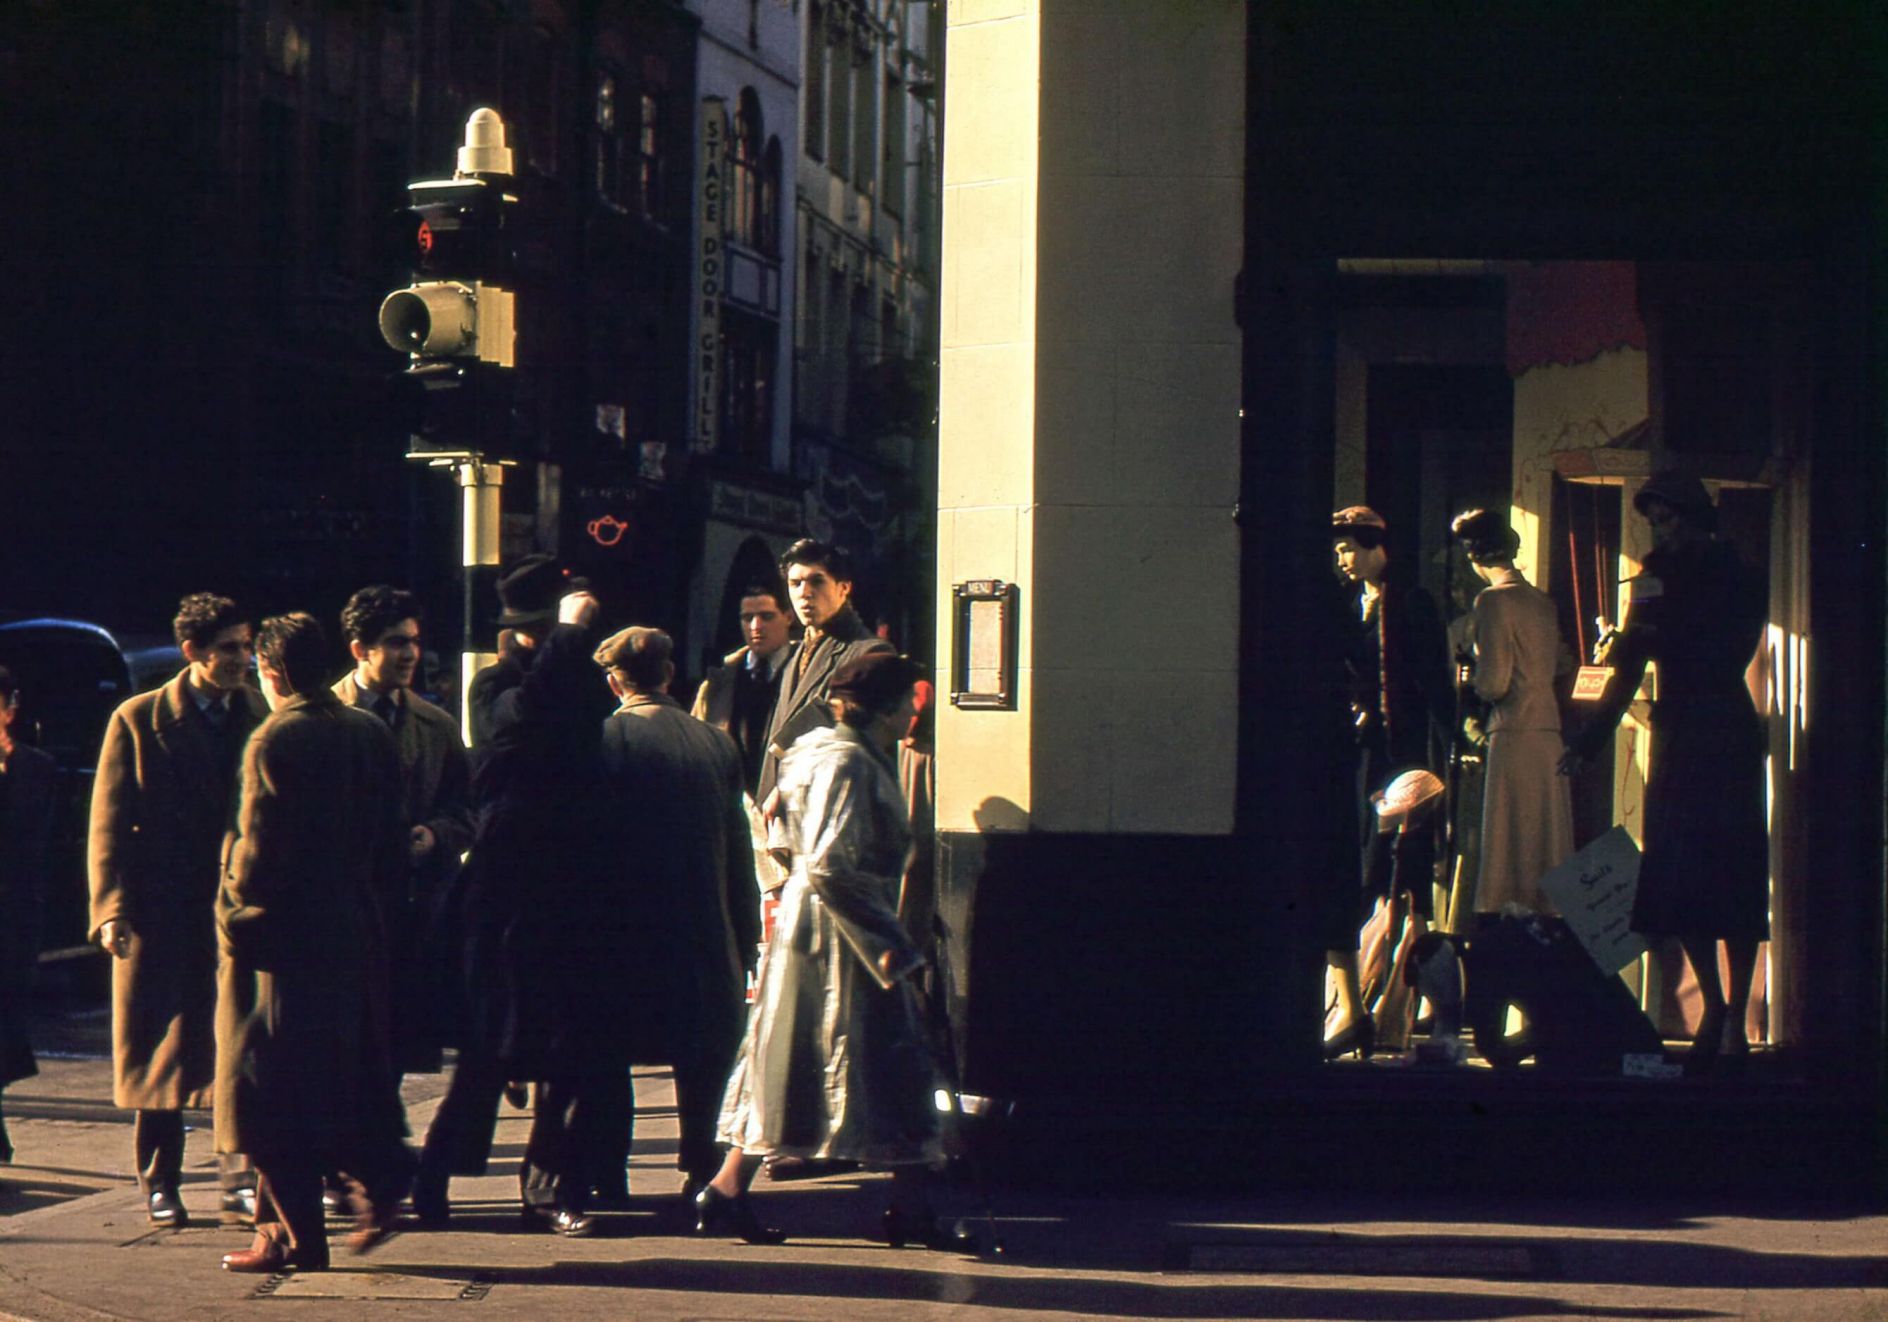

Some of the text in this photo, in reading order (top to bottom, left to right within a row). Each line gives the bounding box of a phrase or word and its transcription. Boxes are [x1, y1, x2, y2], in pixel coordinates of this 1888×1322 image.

[701, 120, 720, 436] STAGE DOOR GRILL
[967, 582, 991, 594] MENU
